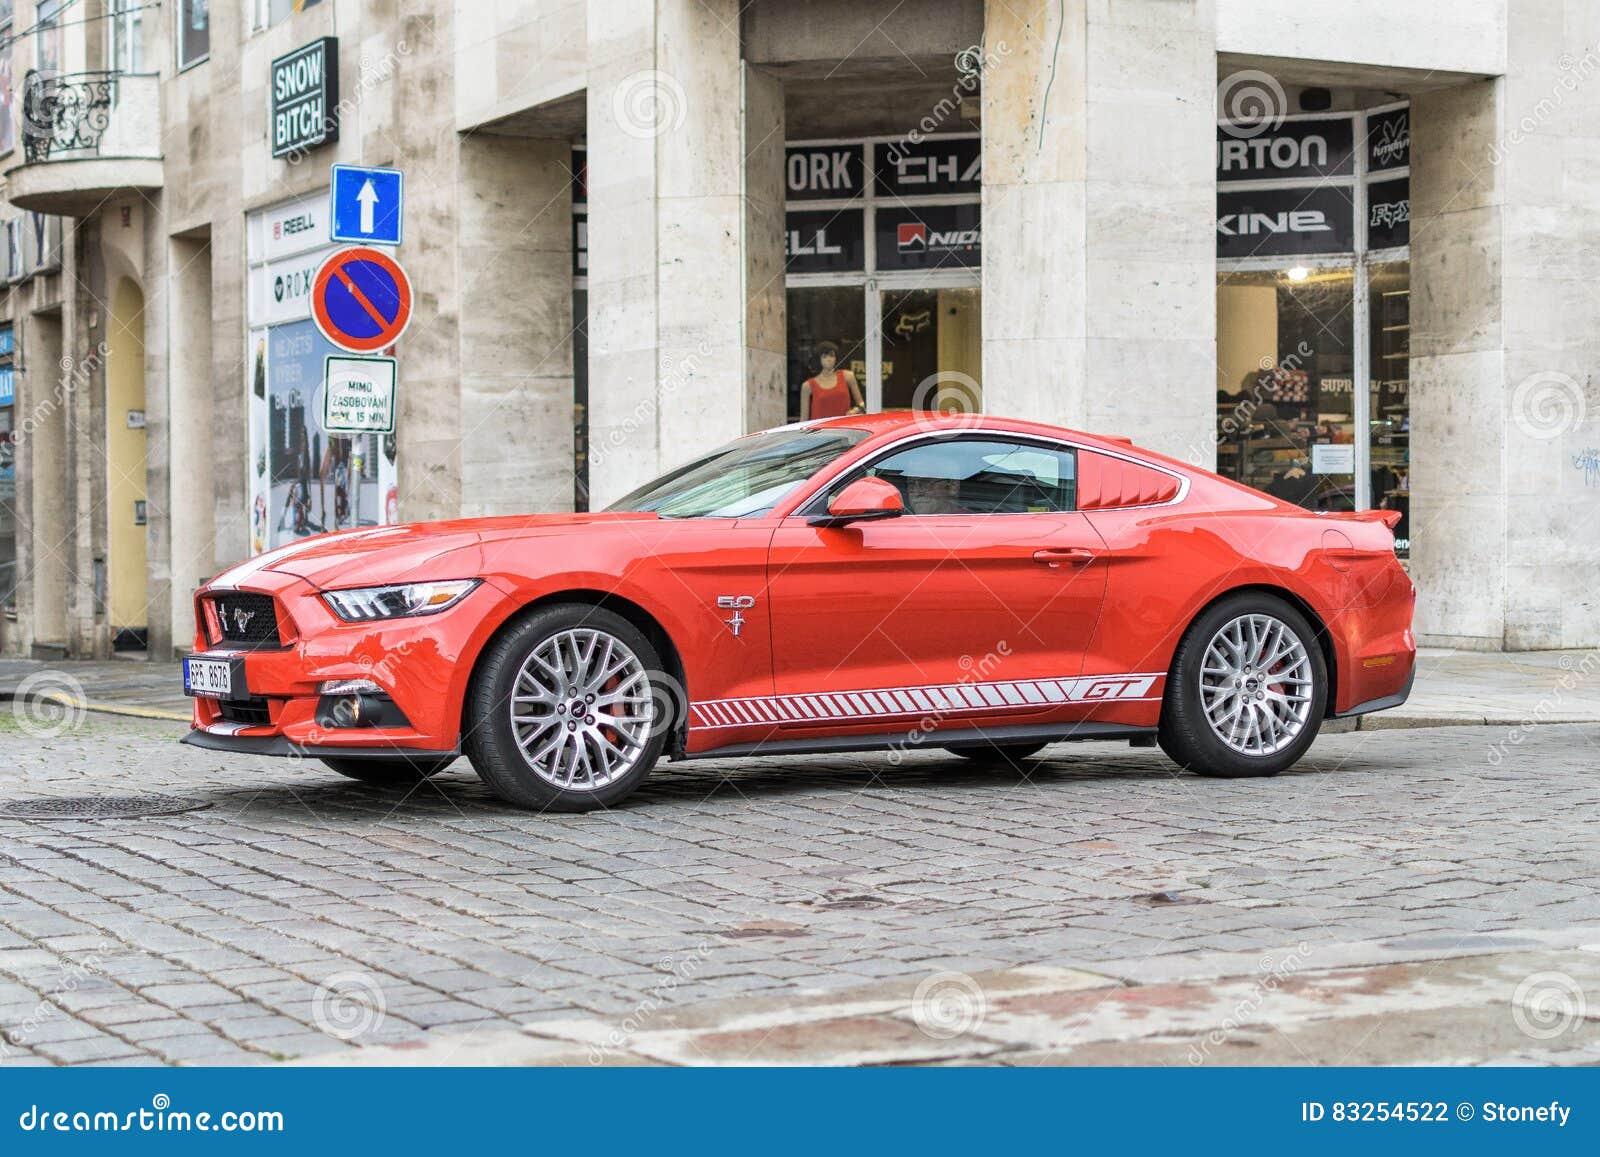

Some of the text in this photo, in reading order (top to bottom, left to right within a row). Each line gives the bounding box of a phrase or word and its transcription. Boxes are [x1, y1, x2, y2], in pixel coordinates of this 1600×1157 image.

[276, 51, 321, 100] SNOW
[276, 97, 322, 146] BITCH
[1217, 135, 1327, 171] RTON
[786, 152, 852, 191] ORK
[898, 155, 981, 184] CHA
[283, 213, 315, 237] REELL
[1217, 211, 1332, 235] KINE
[786, 230, 841, 255] LL
[928, 231, 981, 245] NID
[286, 267, 316, 299] ROX
[348, 381, 373, 392] MIMO
[356, 411, 365, 422] 15
[209, 665, 228, 689] 8676
[1082, 680, 1142, 699] GT
